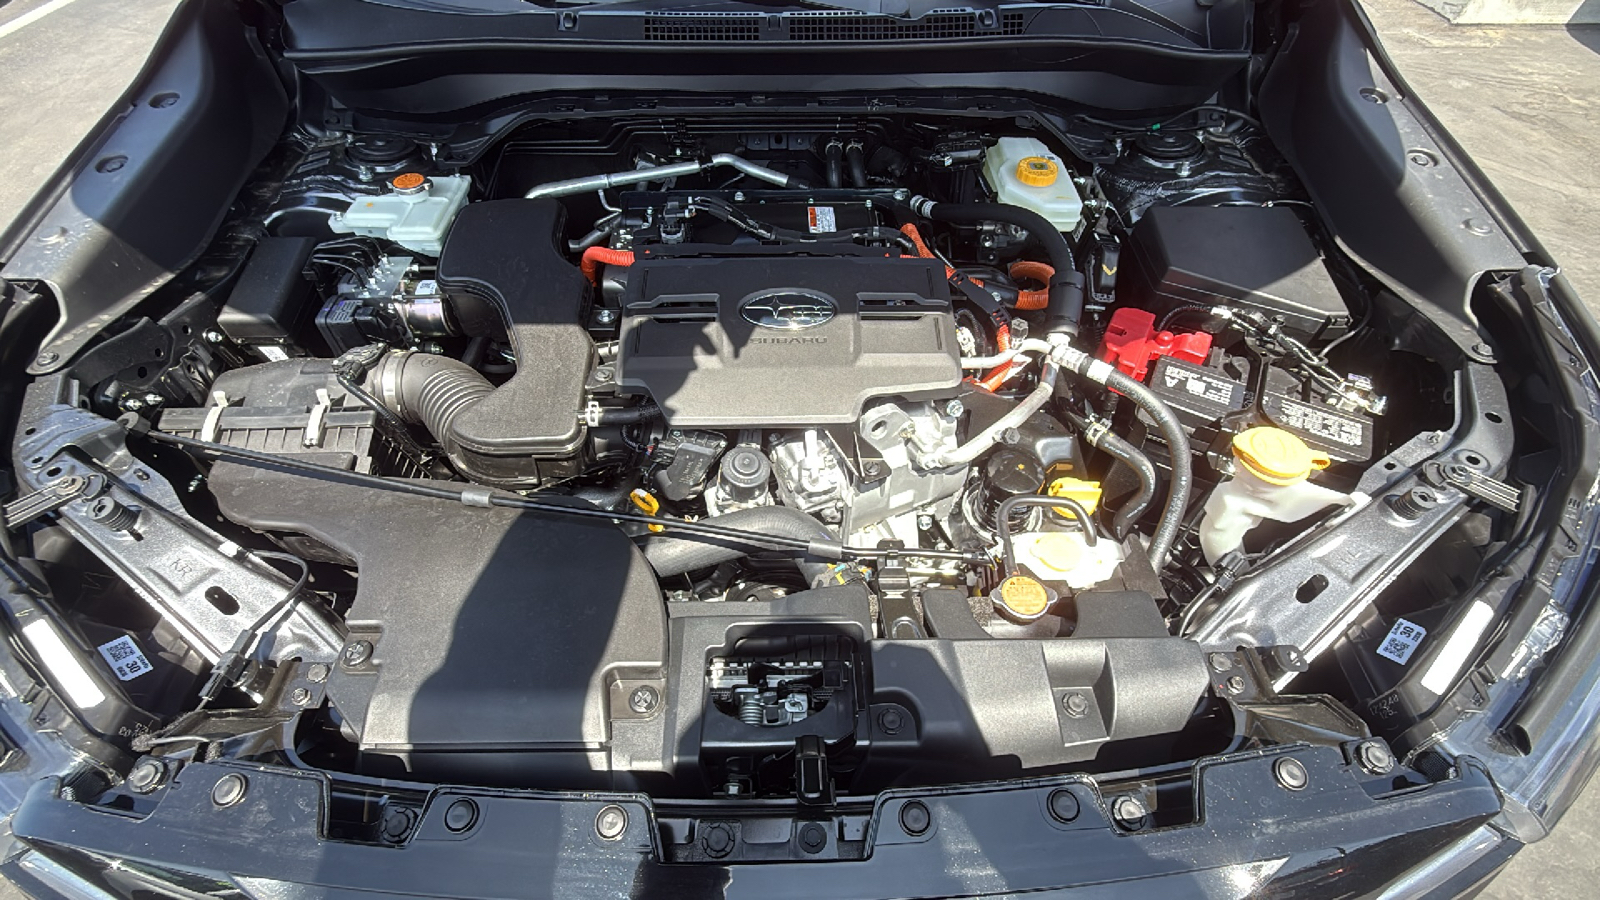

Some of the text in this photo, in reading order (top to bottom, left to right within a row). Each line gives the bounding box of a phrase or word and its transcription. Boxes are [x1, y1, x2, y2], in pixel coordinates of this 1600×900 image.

[749, 336, 828, 344] SUBARU
[1399, 626, 1416, 638] 30
[126, 660, 142, 674] 30
